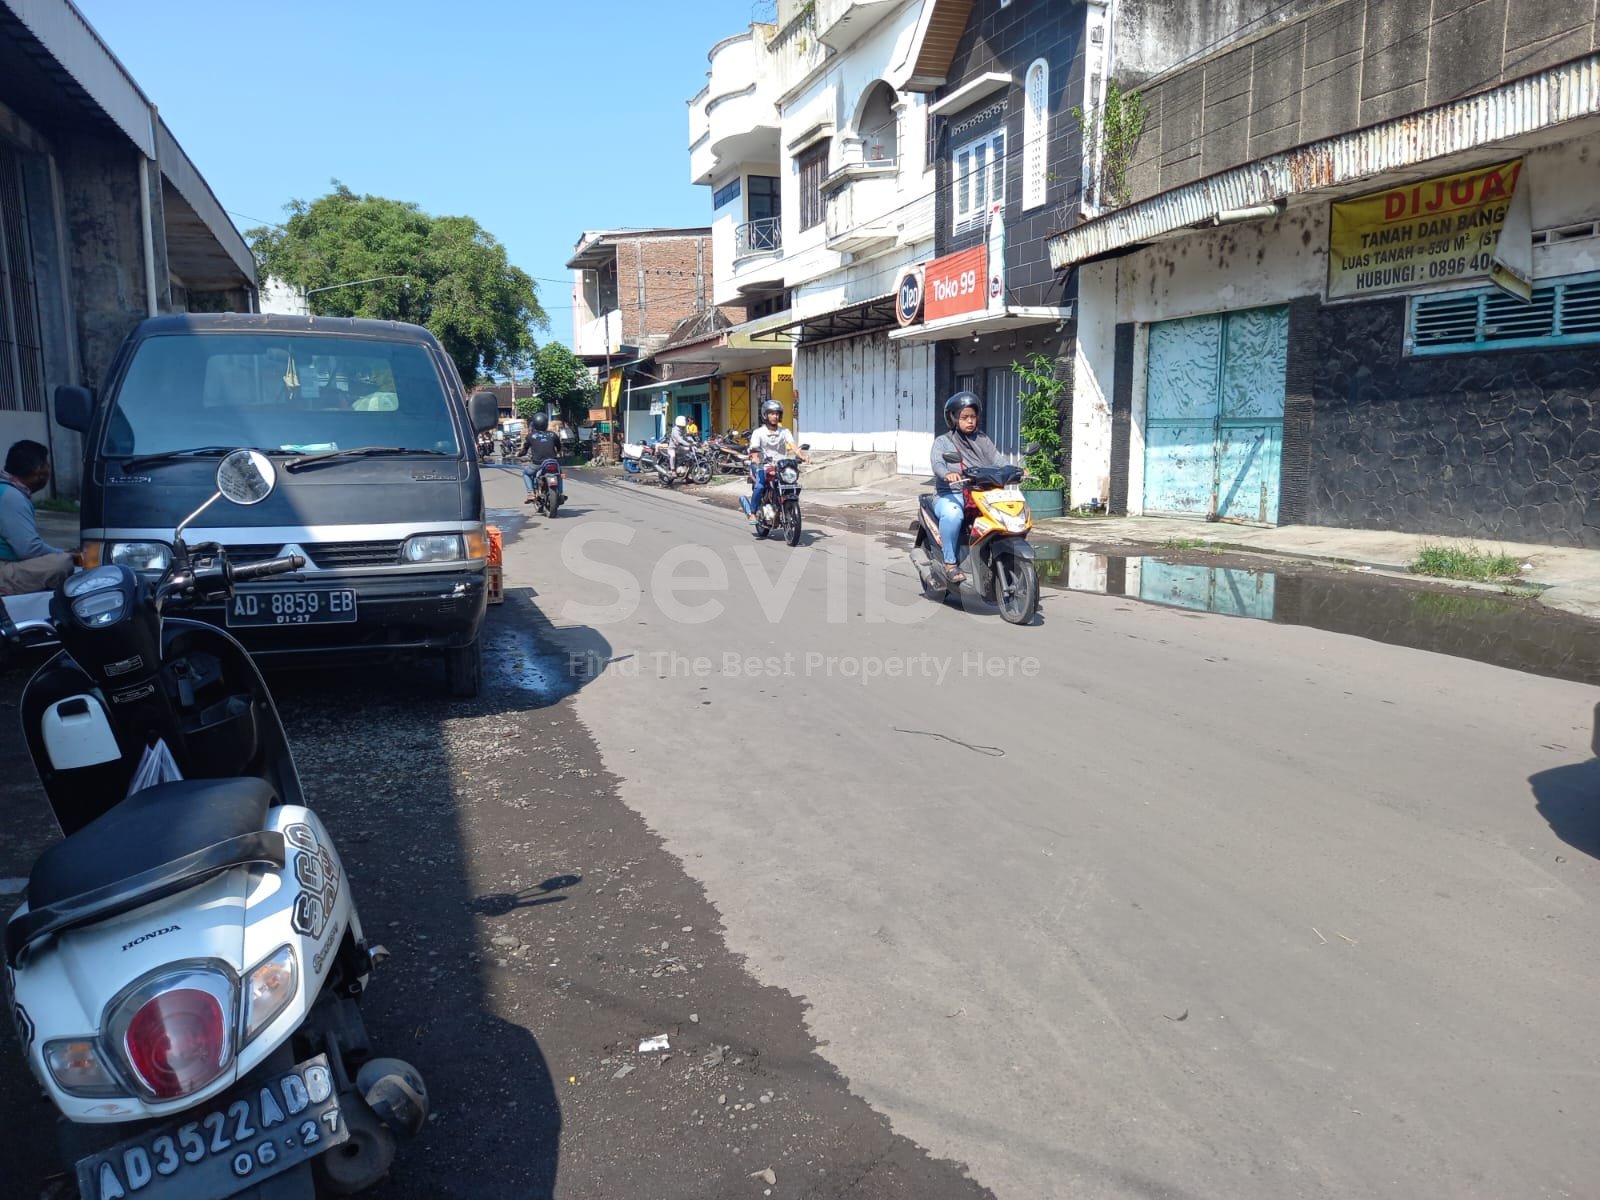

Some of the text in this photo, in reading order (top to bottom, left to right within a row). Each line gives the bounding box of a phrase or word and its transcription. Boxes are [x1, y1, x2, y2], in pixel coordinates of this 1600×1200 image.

[1361, 207, 1509, 249] TANAH DAN BANG
[1342, 254, 1370, 271] LUAS
[1374, 245, 1414, 266] TANAH
[1428, 240, 1450, 256] 550
[933, 274, 958, 302] Toko
[960, 269, 976, 295] 99
[1356, 265, 1416, 290] HUBUNGI
[1429, 257, 1466, 279] 0896
[901, 284, 918, 310] Cleo
[234, 591, 353, 616] AD 8859 EB
[121, 923, 182, 952] HONDA
